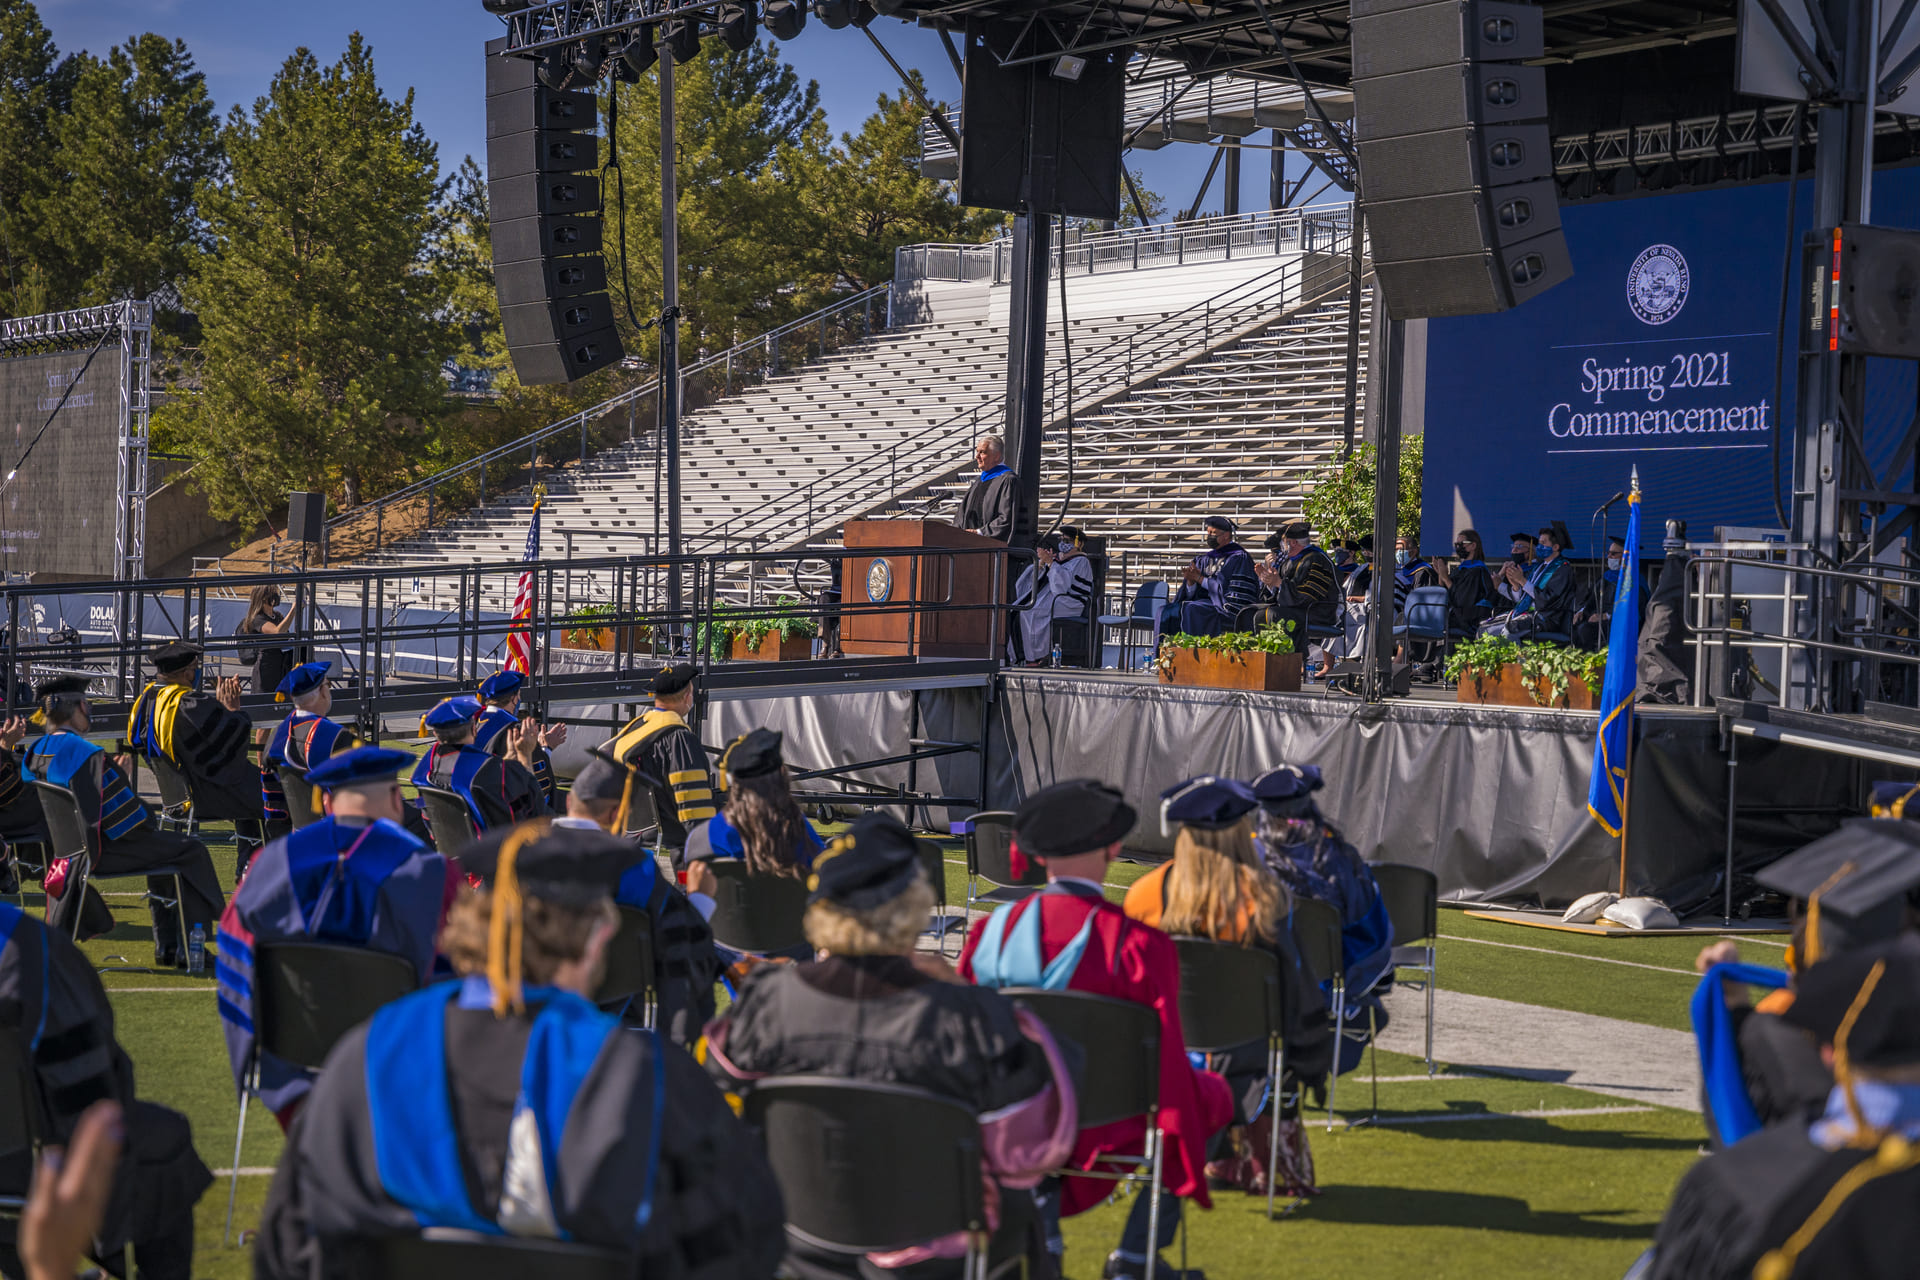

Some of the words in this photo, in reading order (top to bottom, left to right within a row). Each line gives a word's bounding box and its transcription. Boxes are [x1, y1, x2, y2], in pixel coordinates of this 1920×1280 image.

[1629, 252, 1649, 297] UNIVERSITY
[1650, 247, 1659, 257] OF
[1661, 248, 1683, 268] NEVADA
[1680, 269, 1688, 293] RENO
[1581, 357, 1666, 404] Spring
[1670, 352, 1732, 388] 2021
[1548, 399, 1770, 438] Commencement
